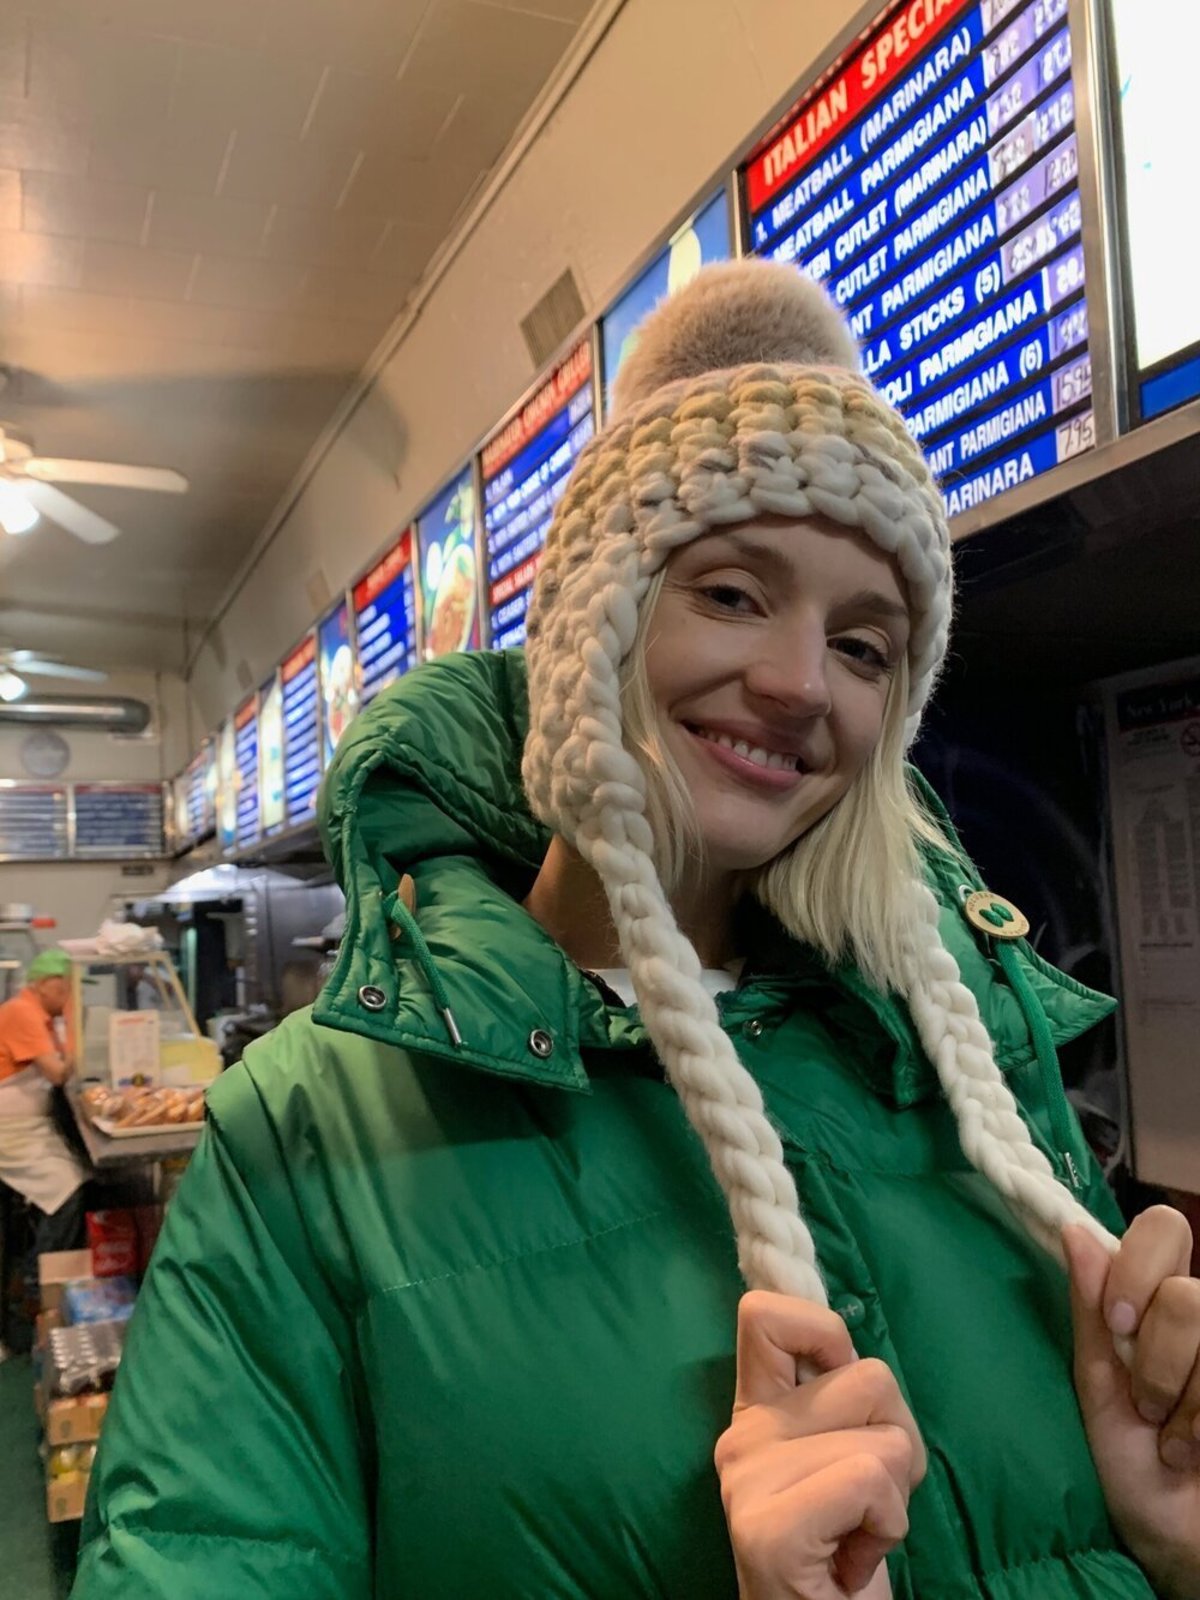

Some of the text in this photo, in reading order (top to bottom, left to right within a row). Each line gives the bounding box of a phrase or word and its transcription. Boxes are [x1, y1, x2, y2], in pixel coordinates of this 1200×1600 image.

[762, 80, 849, 186] ITALIAN
[771, 144, 853, 230] MEATBALL
[860, 26, 971, 152] (MARINARA)
[860, 77, 975, 194] PARMIGIANA
[835, 198, 888, 262] CUTLET
[894, 116, 987, 216] (MARINARA)
[835, 245, 888, 304] CUTLET
[893, 167, 989, 260] PARMIGIANA
[881, 214, 995, 317] PARMIGIANA
[900, 286, 965, 350] STICKS
[974, 261, 1000, 303] (5)
[904, 339, 1043, 438] PARMIGIANA (6)
[919, 290, 1037, 386] PARMIGIANA
[960, 390, 1046, 460] PARMIGIANA
